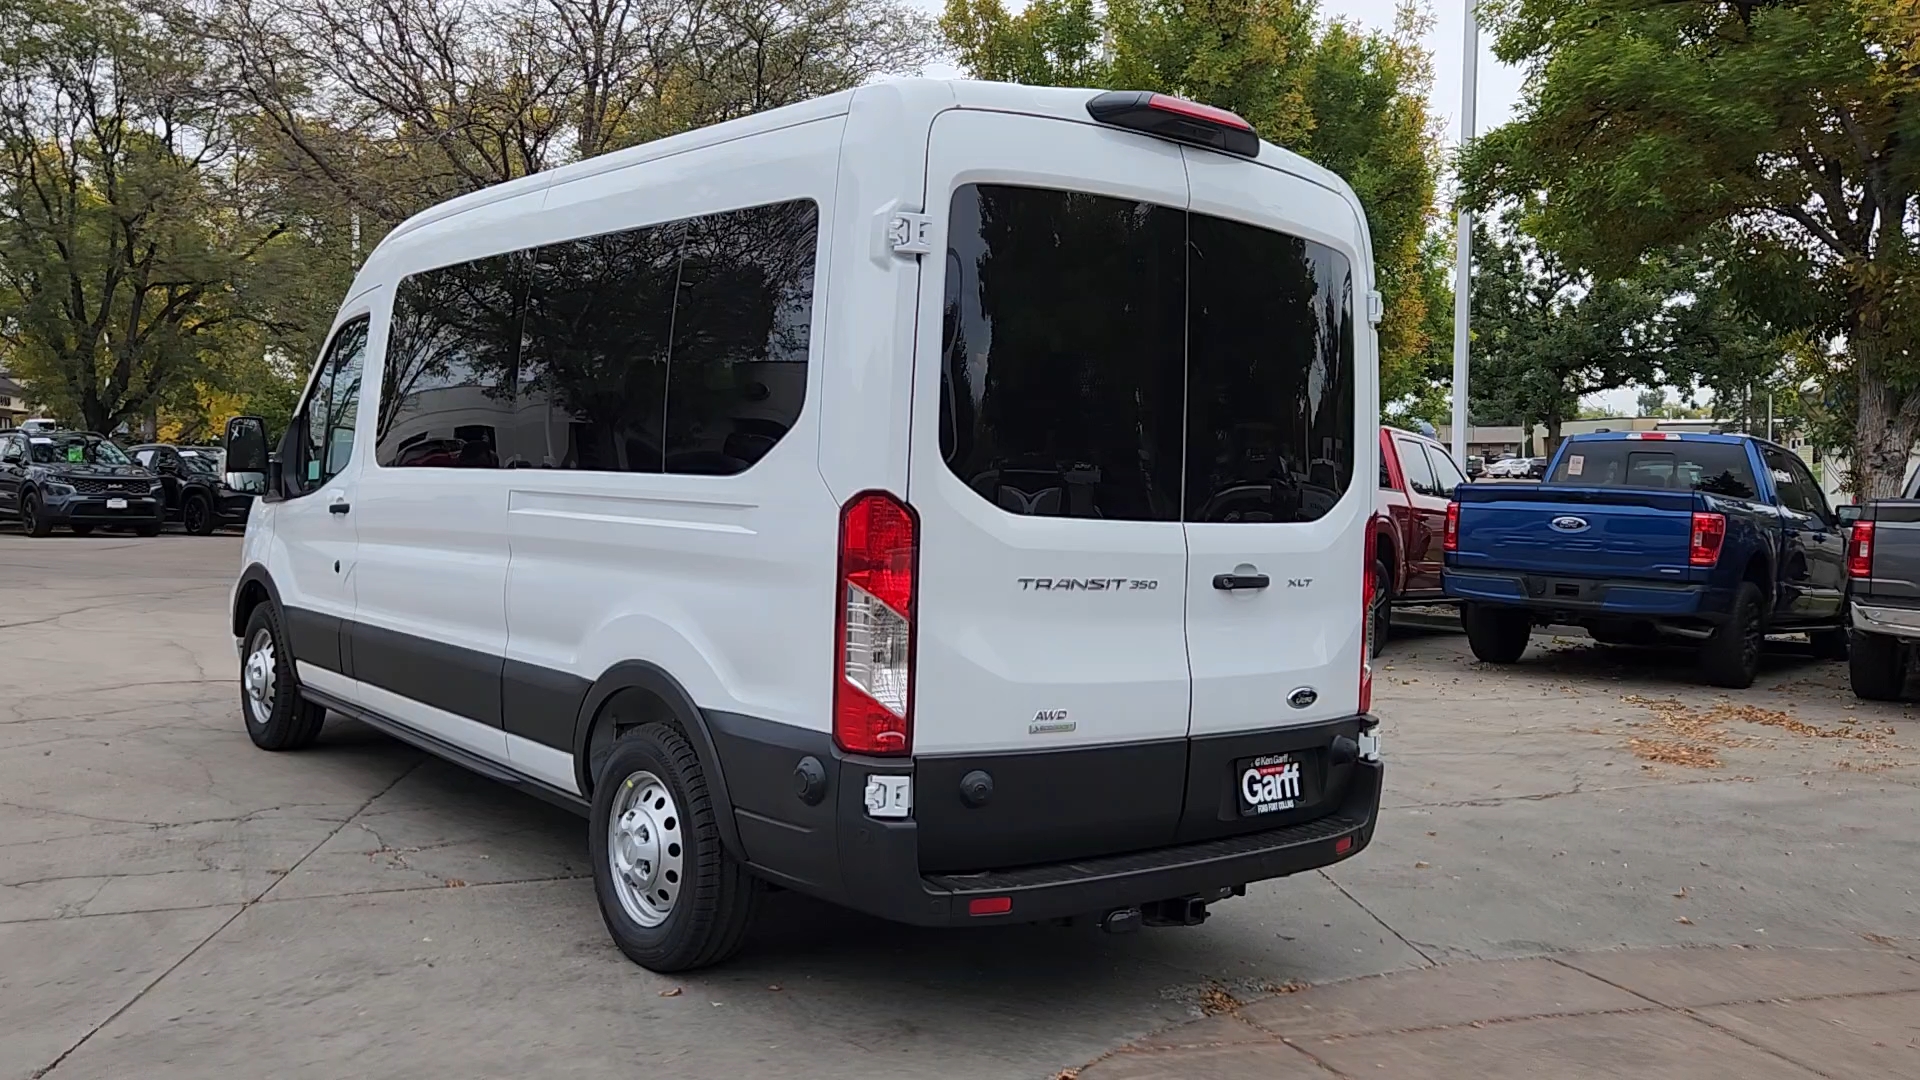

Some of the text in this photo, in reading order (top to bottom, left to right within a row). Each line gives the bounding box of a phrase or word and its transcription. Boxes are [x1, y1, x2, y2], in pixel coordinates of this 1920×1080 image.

[1017, 578, 1158, 591] TRANSIT 350
[1287, 578, 1313, 588] XLT
[1032, 708, 1067, 721] AWD
[1242, 762, 1300, 805] Garff
